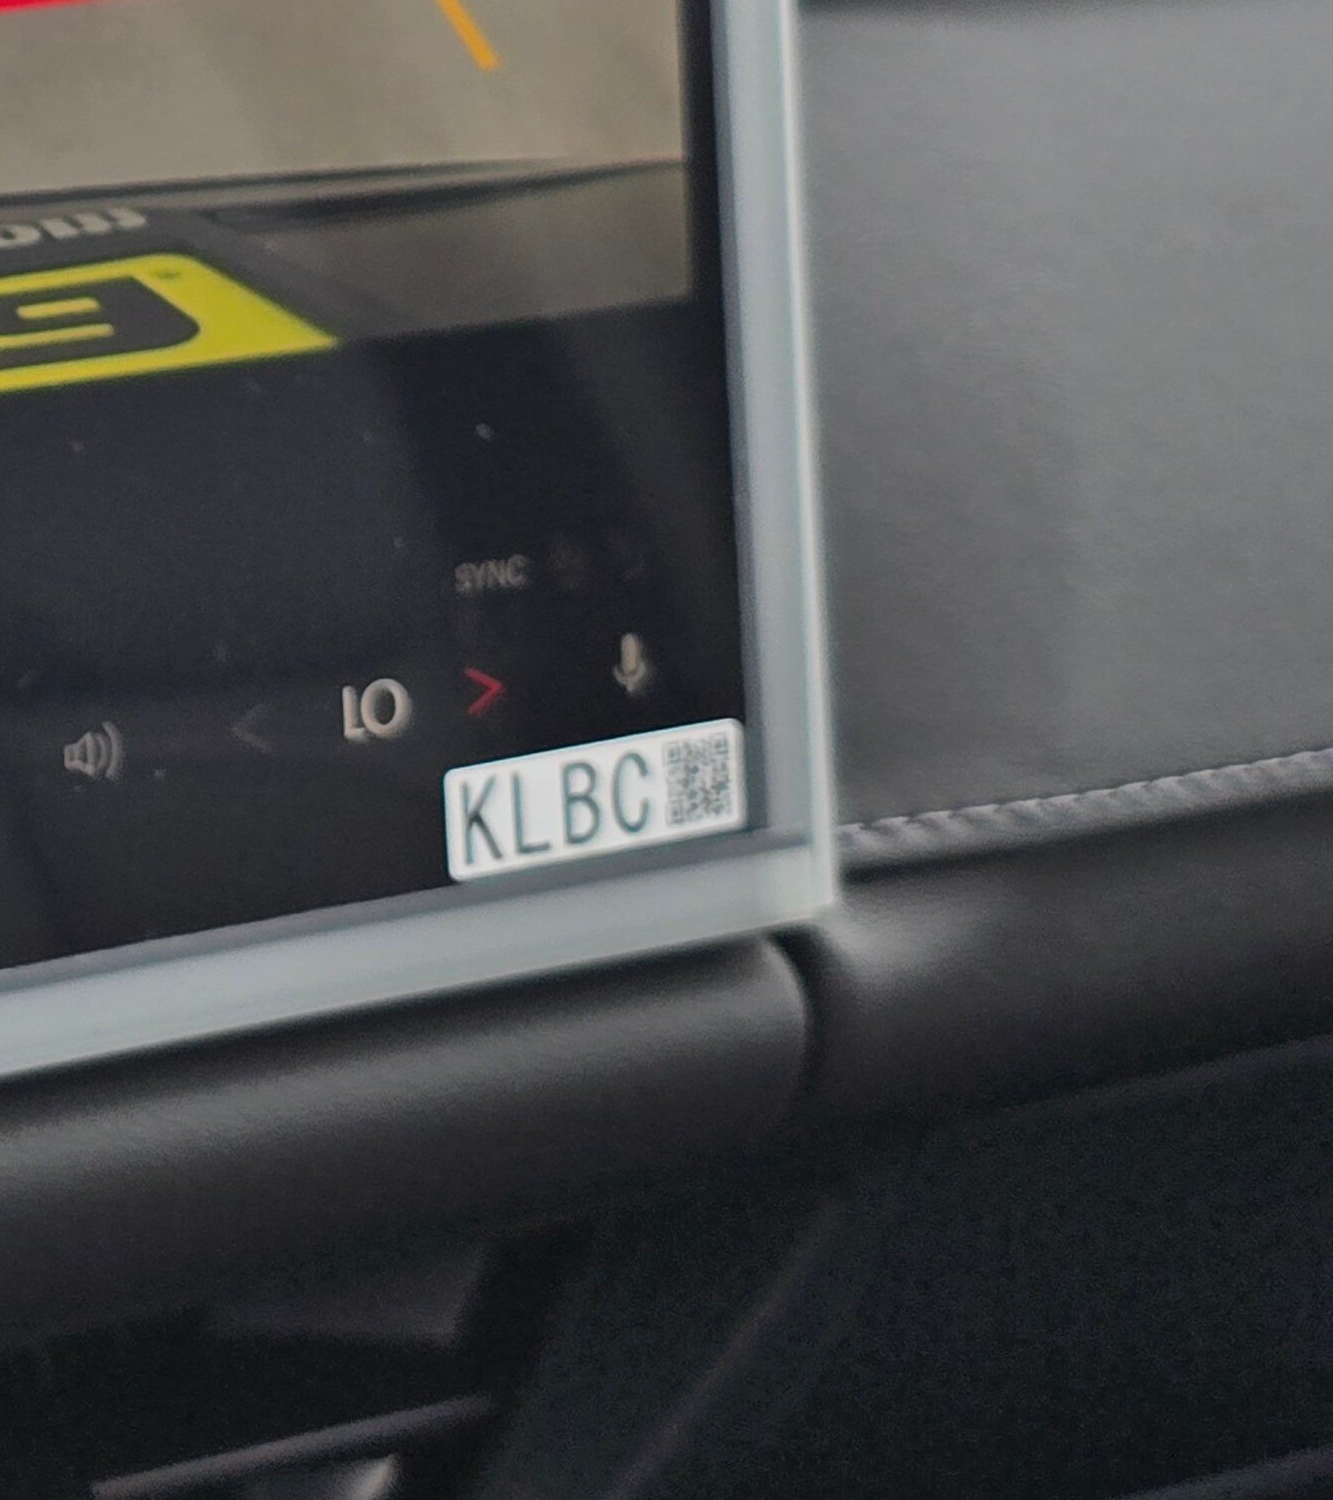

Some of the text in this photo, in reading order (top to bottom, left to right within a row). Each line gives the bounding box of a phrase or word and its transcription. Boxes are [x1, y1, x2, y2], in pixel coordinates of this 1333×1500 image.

[454, 553, 531, 593] SYNC
[341, 677, 413, 742] LO
[460, 750, 652, 867] KLBC
